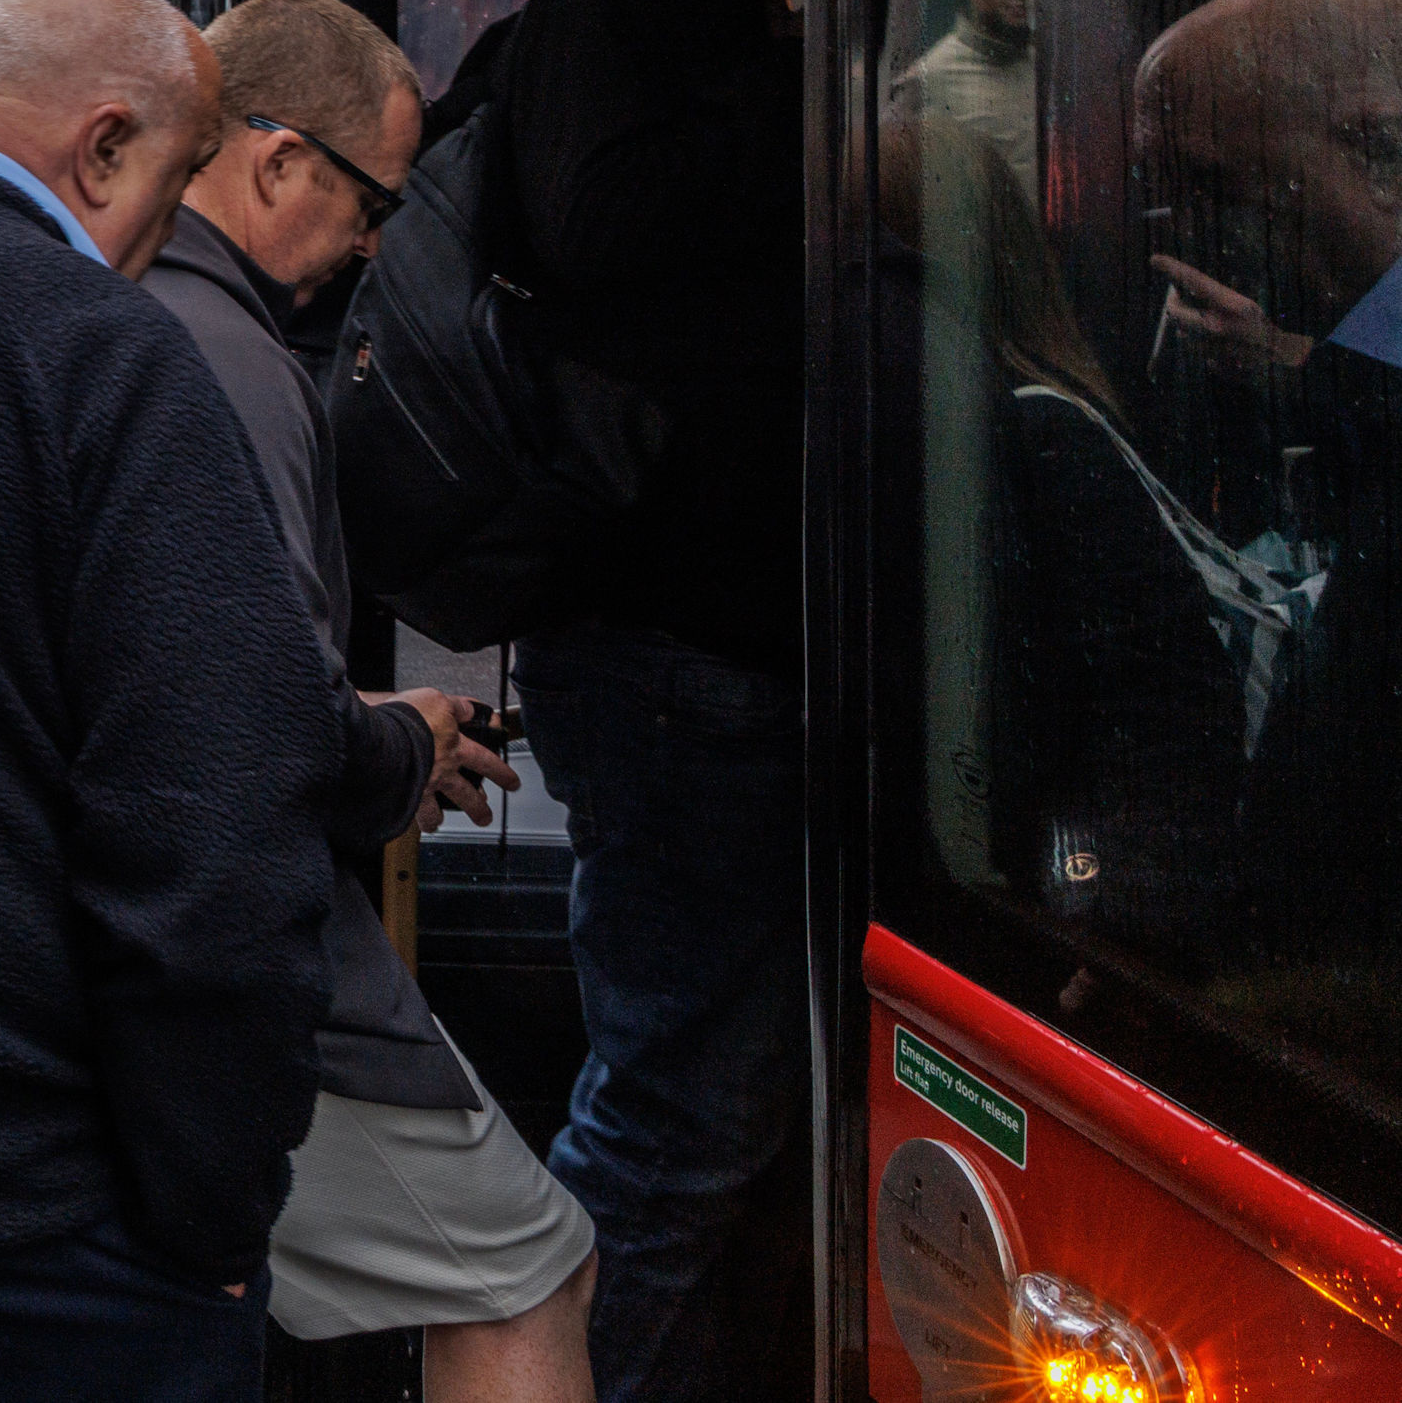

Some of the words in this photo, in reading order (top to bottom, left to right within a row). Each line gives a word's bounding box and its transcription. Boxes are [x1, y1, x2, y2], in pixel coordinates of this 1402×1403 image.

[900, 1061, 914, 1080] Lift
[914, 1072, 930, 1094] flap
[900, 1039, 954, 1089] Emergency
[954, 1078, 979, 1105] door
[981, 1098, 1019, 1134] release
